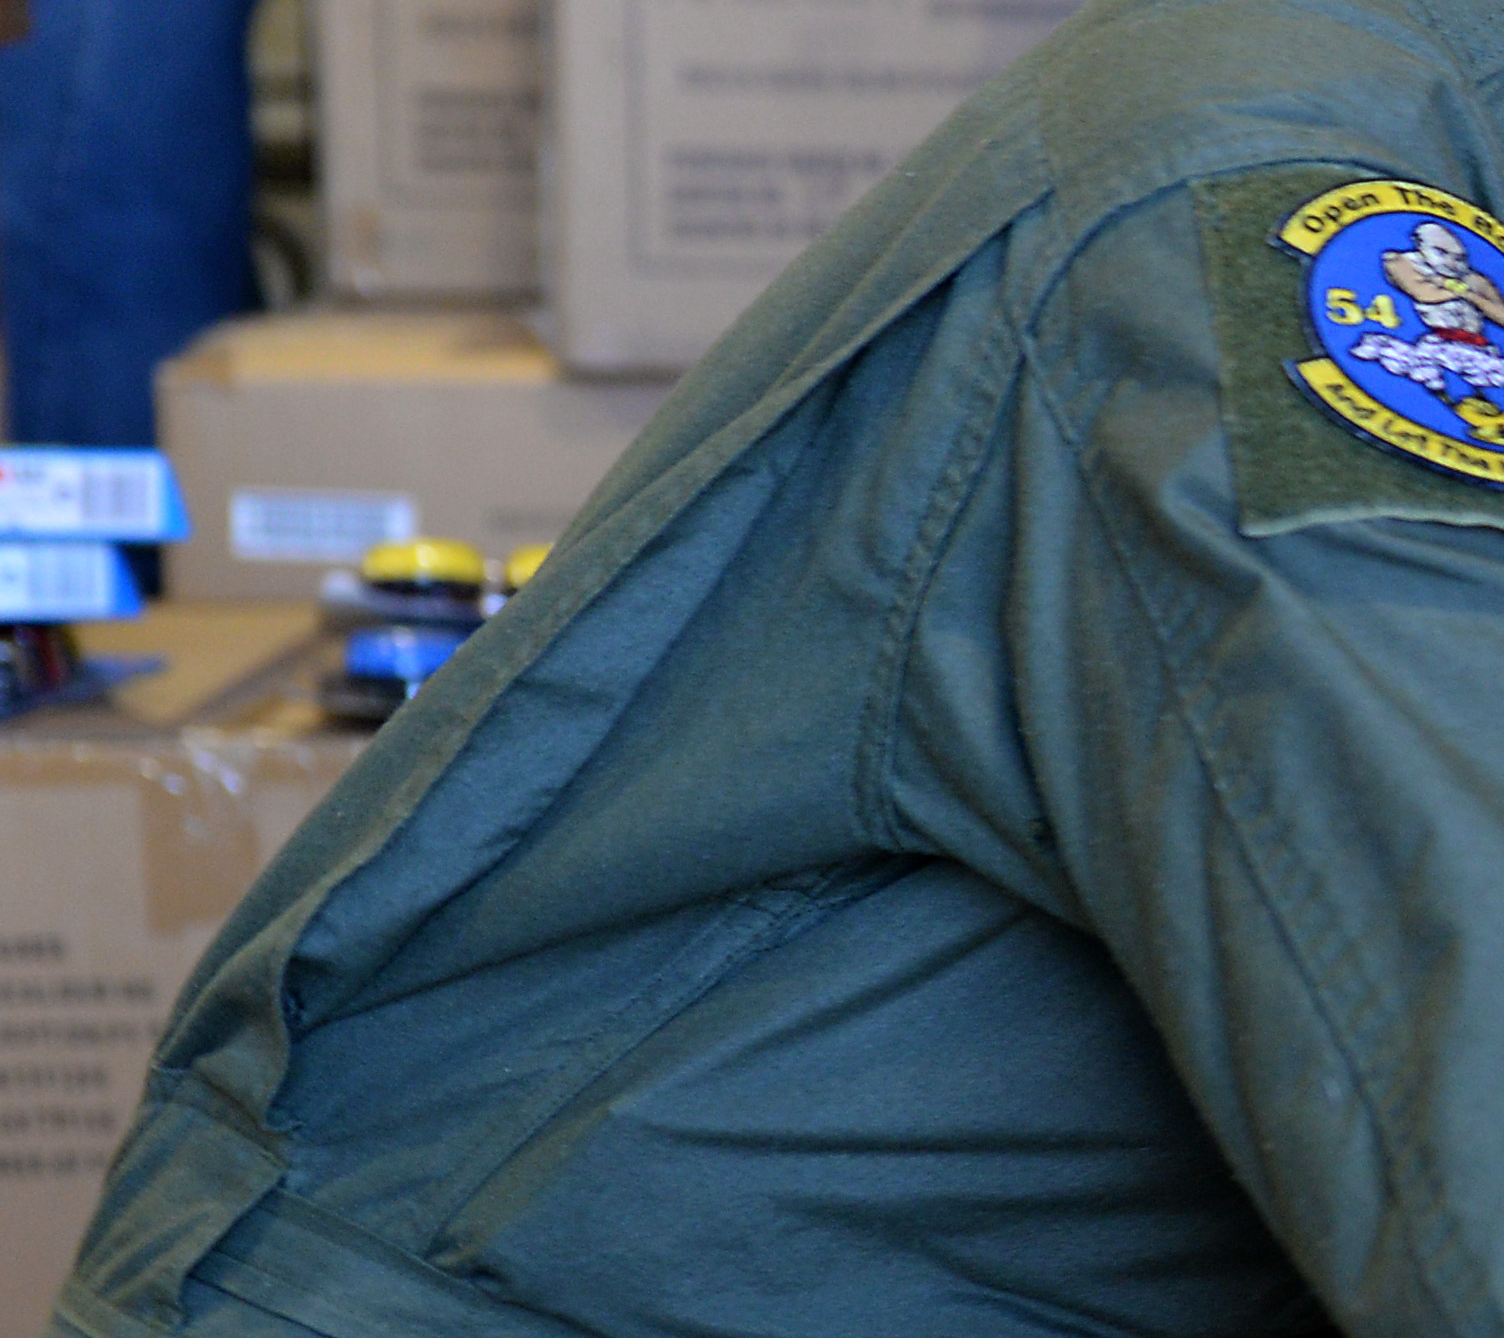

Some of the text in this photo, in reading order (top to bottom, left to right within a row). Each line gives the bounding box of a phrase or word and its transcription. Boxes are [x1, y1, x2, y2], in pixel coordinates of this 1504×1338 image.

[1302, 191, 1381, 232] Open
[1393, 186, 1457, 217] The
[1325, 288, 1400, 329] 54
